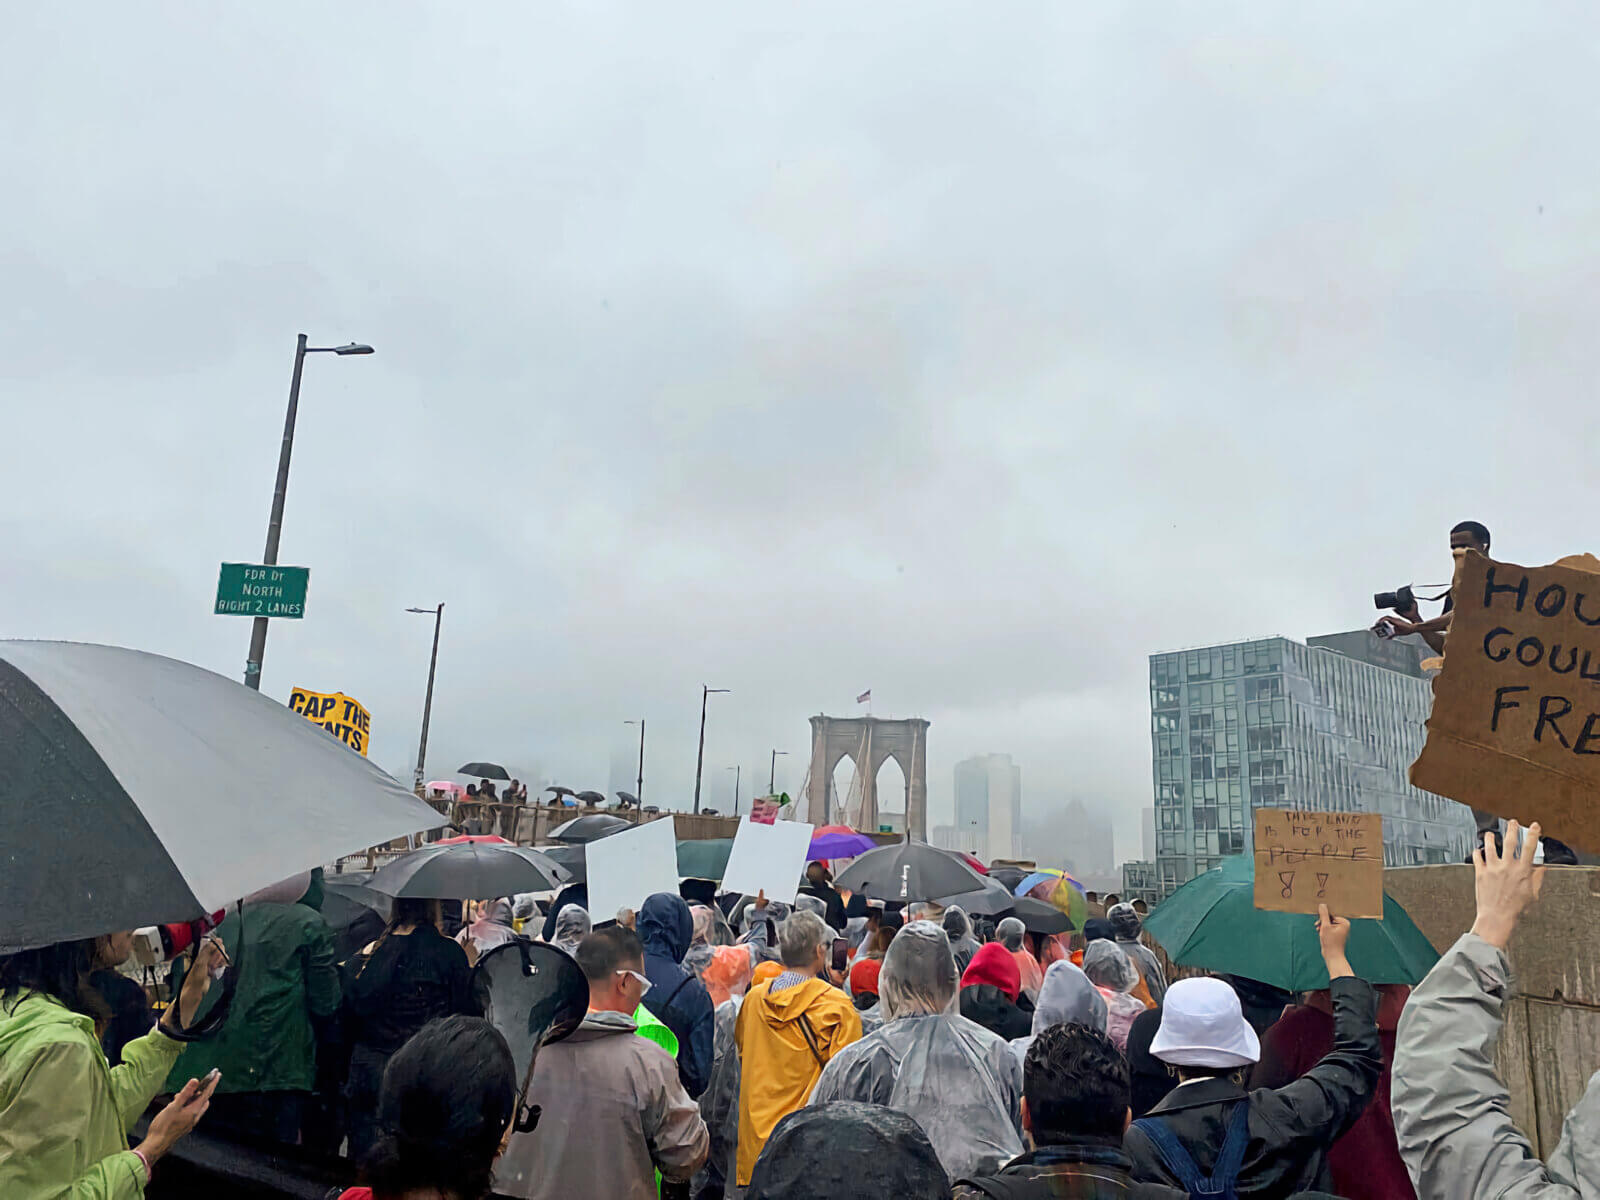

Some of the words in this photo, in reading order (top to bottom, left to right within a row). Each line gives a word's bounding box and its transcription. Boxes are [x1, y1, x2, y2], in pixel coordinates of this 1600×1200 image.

[244, 568, 266, 580] FDR
[271, 570, 286, 581] Dr
[242, 583, 282, 597] NORTH
[218, 600, 251, 611] RIGHT
[254, 600, 264, 613] 2
[267, 602, 301, 615] LANES
[288, 692, 337, 718] CAP
[343, 700, 370, 735] THE
[1285, 812, 1320, 825] THIS
[1293, 826, 1322, 837] FOR
[1333, 828, 1369, 840] THE
